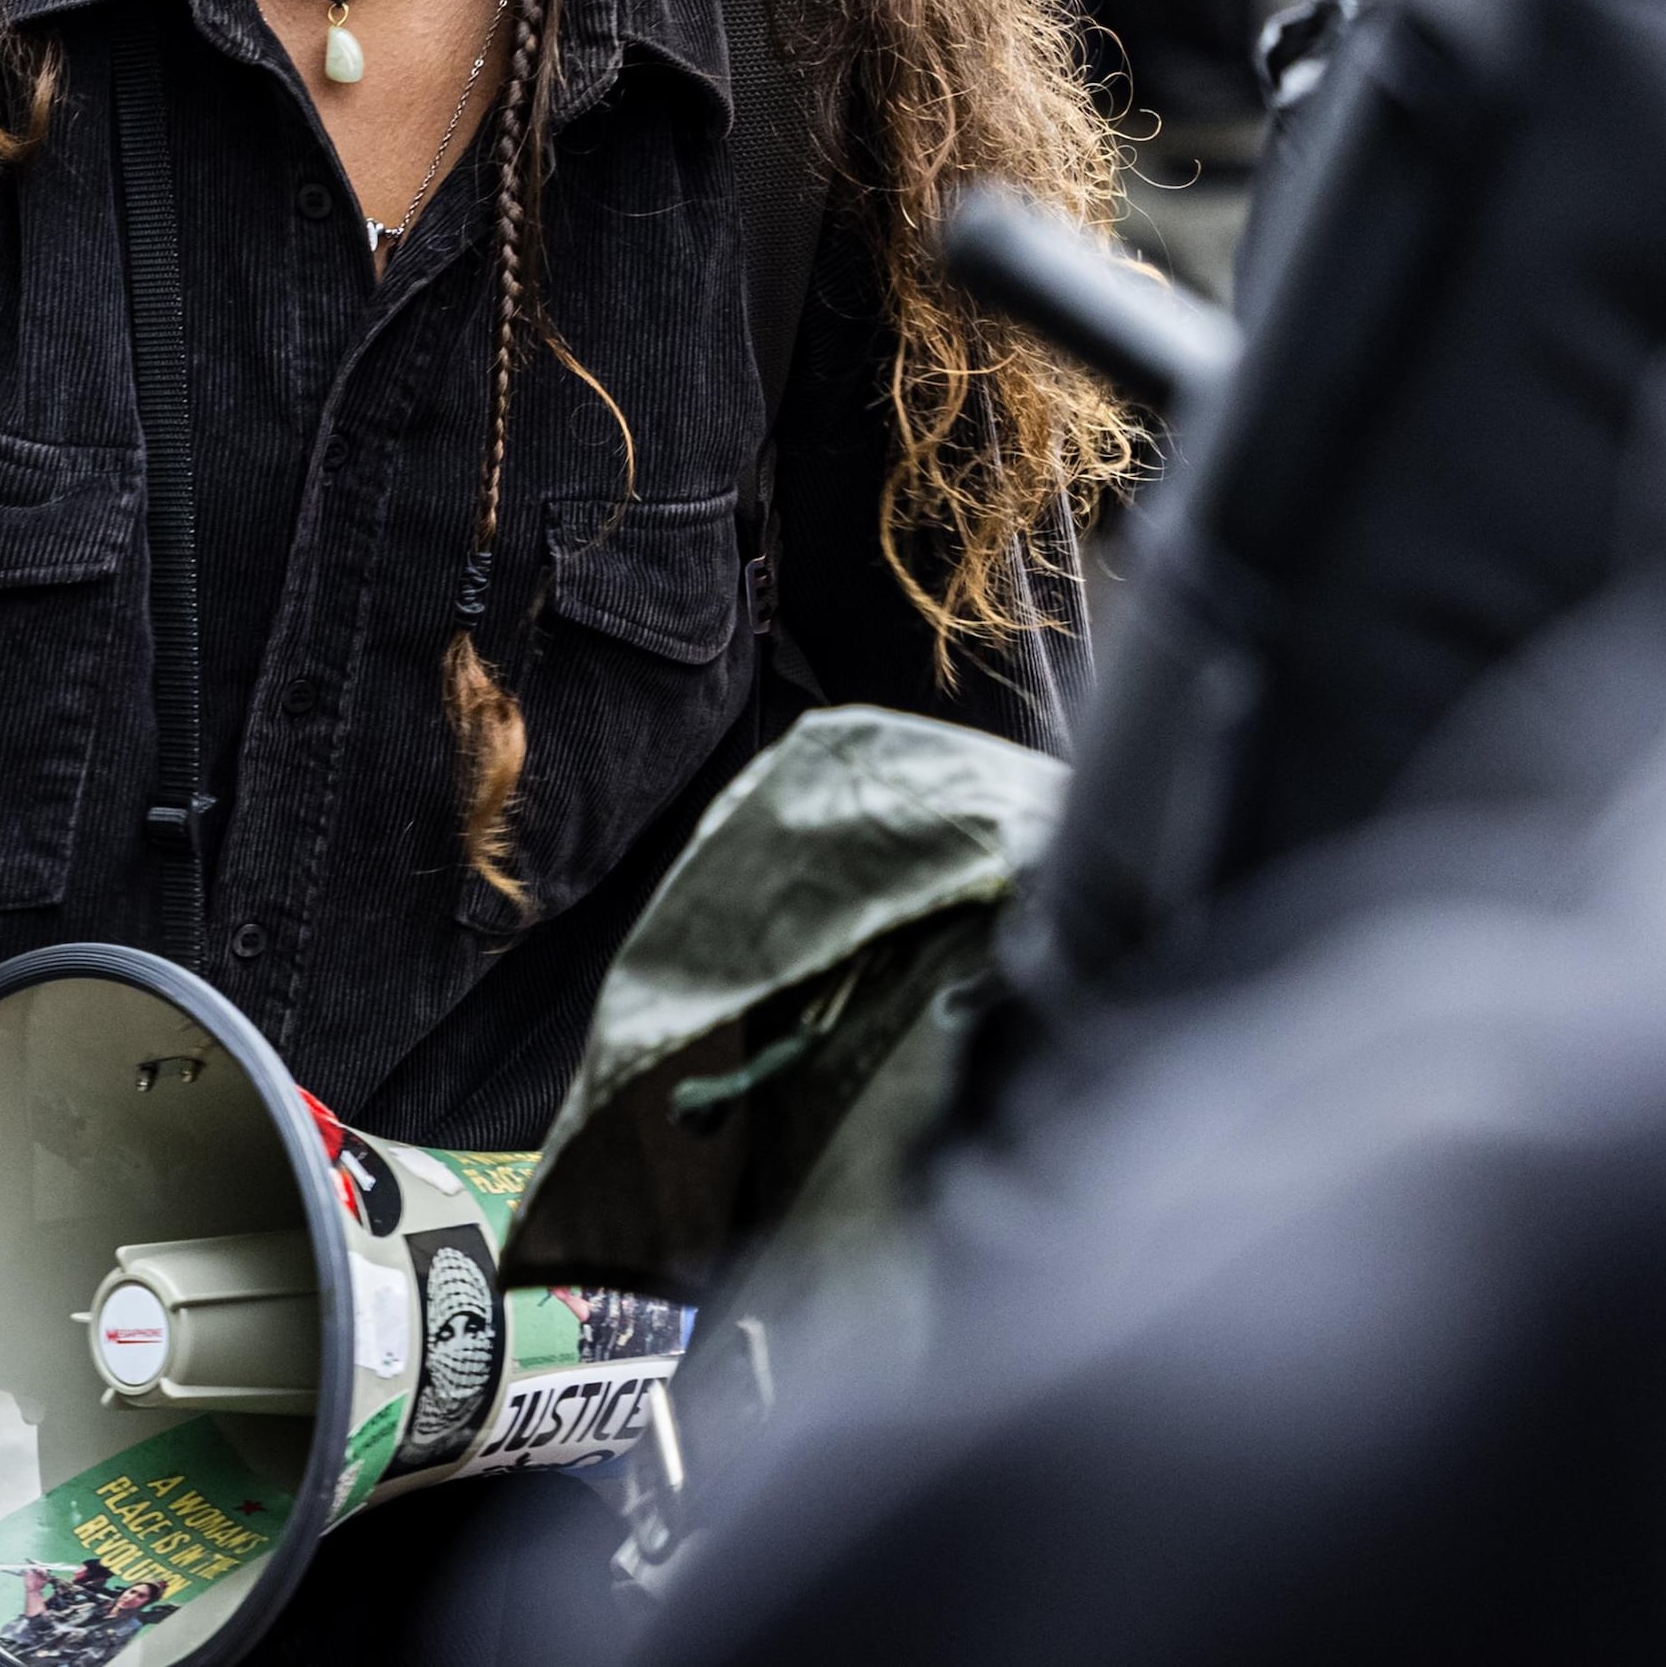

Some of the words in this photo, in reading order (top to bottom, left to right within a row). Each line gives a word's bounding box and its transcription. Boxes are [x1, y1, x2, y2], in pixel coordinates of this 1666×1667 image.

[479, 1376, 668, 1458] JUSTICE
[146, 1475, 185, 1498] A
[95, 1475, 173, 1541] PLACE
[149, 1530, 191, 1555] IS
[167, 1542, 209, 1569] IN
